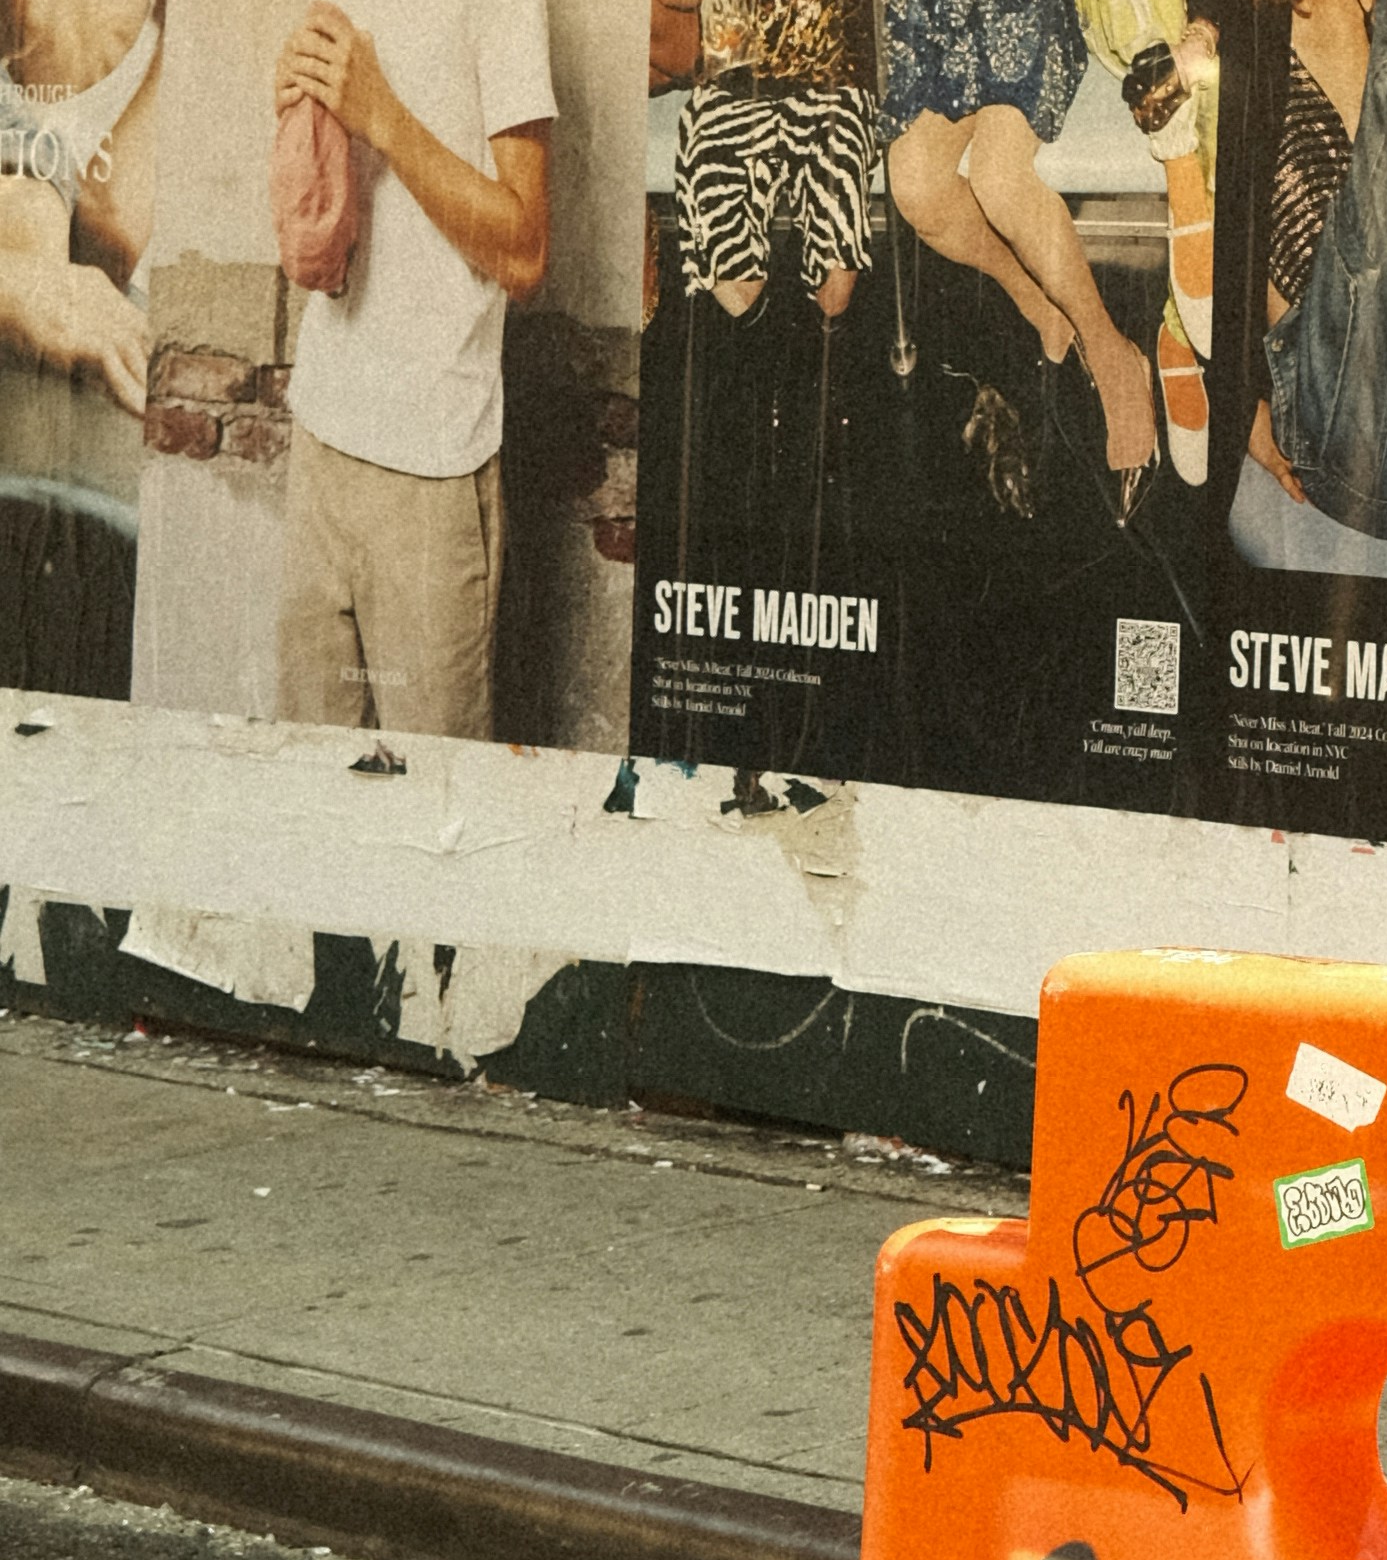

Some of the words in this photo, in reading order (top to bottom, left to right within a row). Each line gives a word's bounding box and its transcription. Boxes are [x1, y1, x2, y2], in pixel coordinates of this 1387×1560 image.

[654, 580, 742, 640] STEVE
[753, 589, 878, 652] MADDEN
[1230, 630, 1332, 696] STEVE
